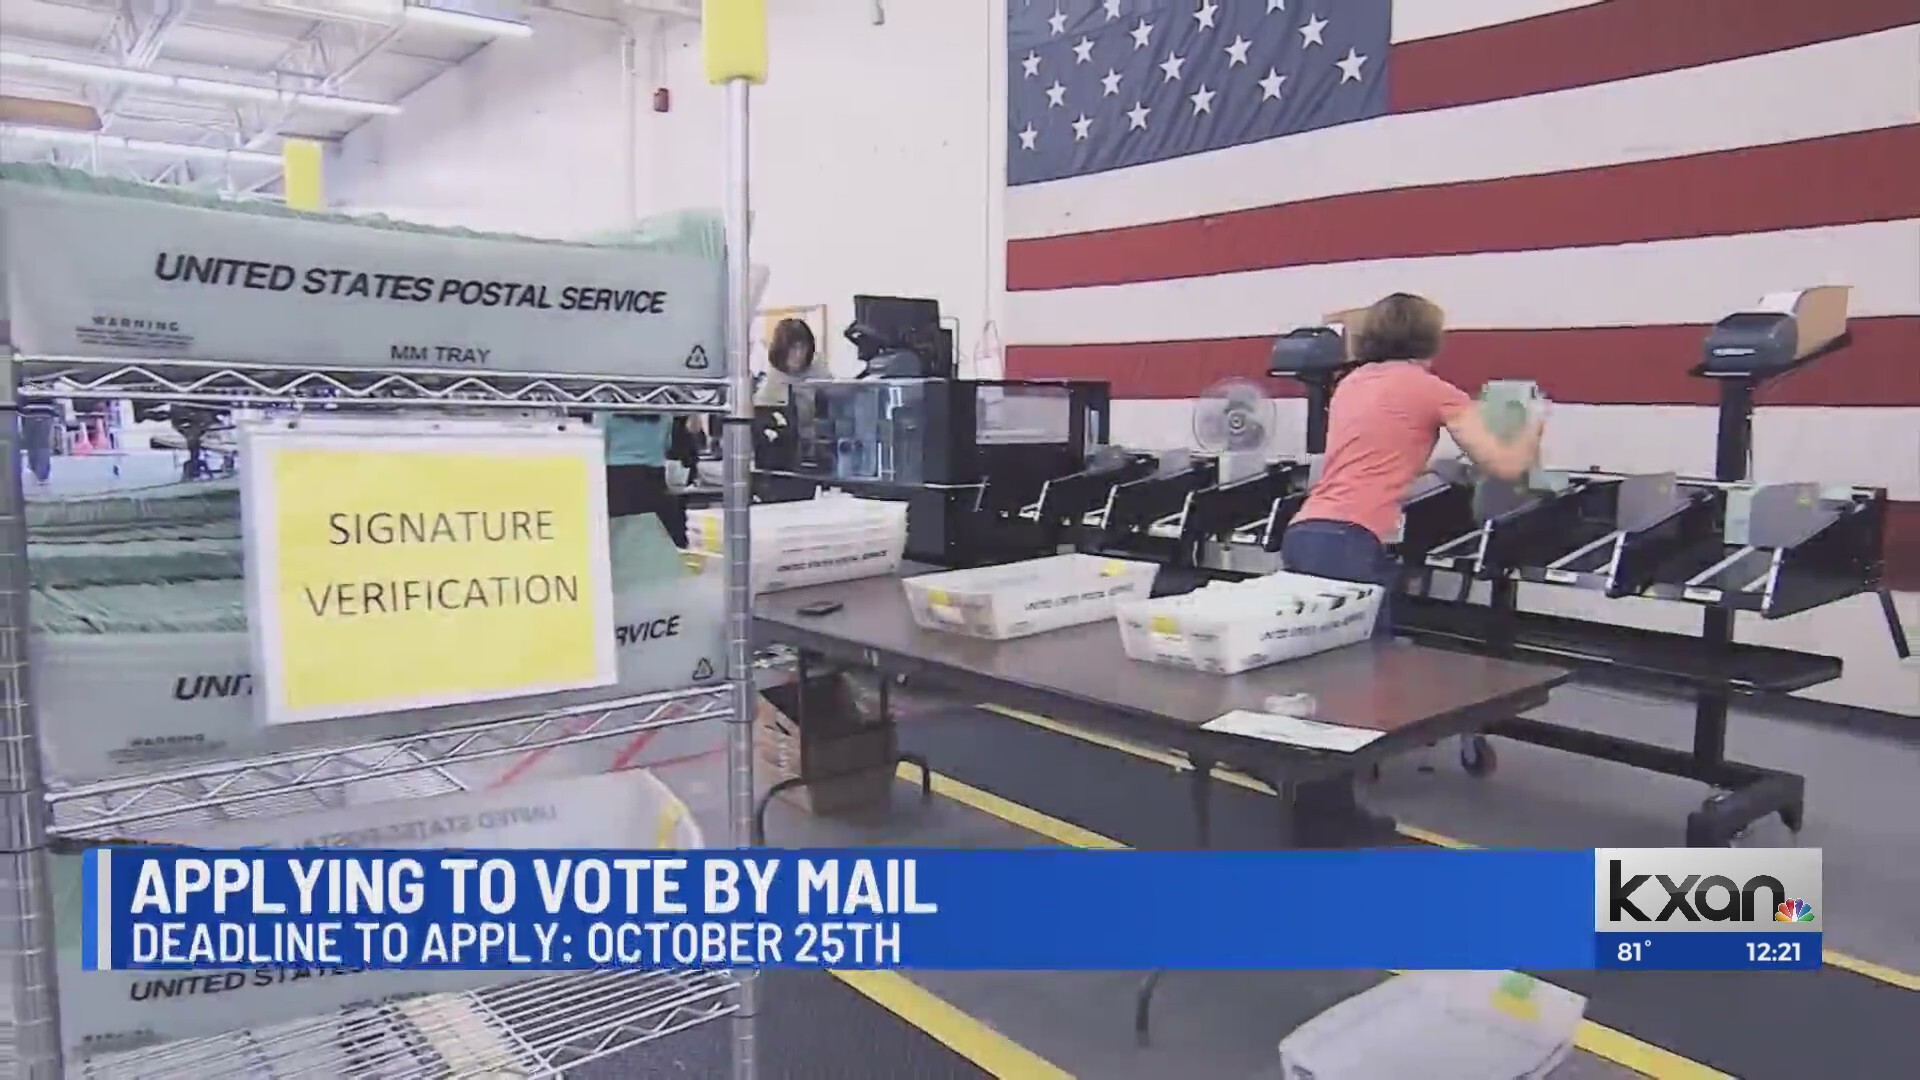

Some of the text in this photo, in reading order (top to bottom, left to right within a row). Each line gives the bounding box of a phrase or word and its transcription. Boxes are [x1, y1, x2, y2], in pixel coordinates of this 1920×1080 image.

[155, 252, 668, 315] UNITED STATES POSTAL SERVICE
[91, 316, 180, 332] WARNING
[391, 345, 491, 365] MM TRAY
[328, 510, 555, 546] SIGNATURE
[304, 573, 578, 618] VERIFICATION
[615, 614, 682, 647] RVICE
[175, 674, 252, 701] UNI
[130, 972, 247, 1001] UNITED
